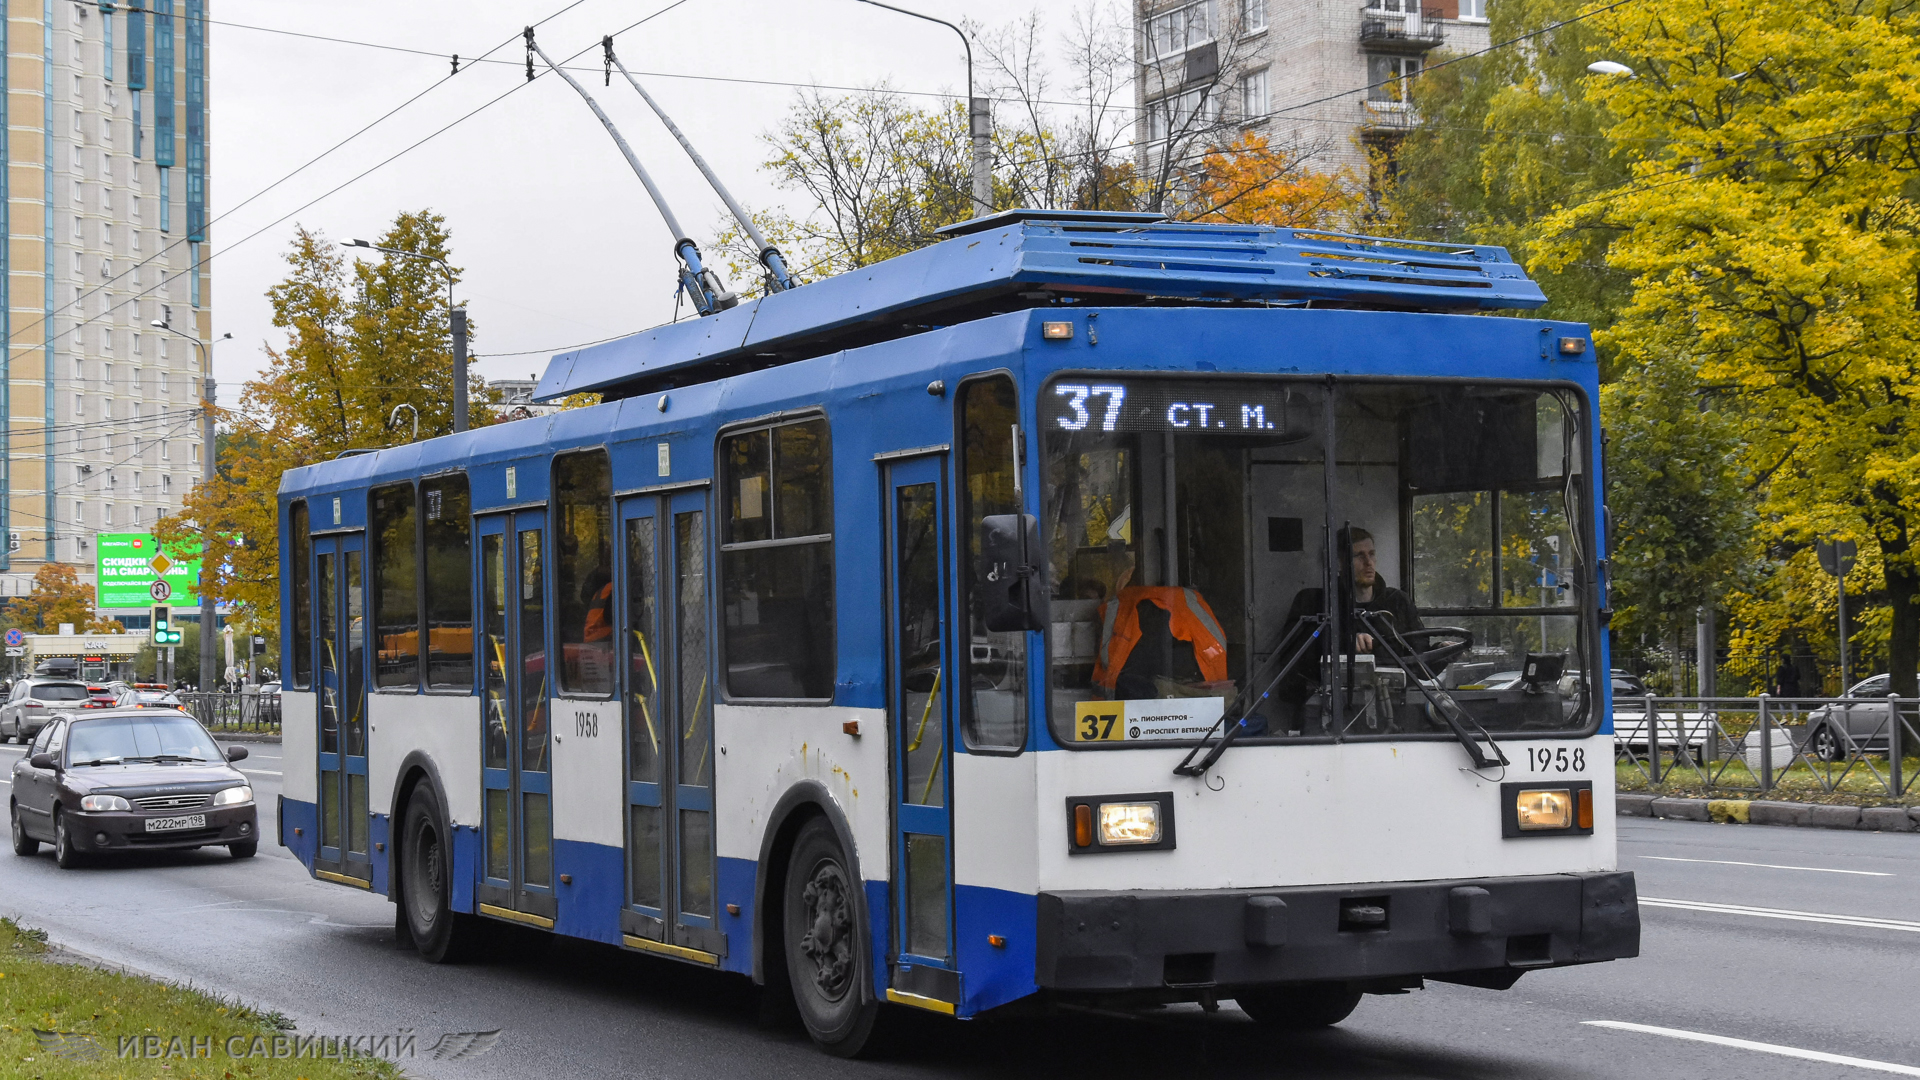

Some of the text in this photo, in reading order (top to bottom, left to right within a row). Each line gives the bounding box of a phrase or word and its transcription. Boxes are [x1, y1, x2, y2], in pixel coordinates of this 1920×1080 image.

[1056, 384, 1275, 431] 37 СТ. М.
[102, 557, 146, 566] СКИДКИ
[103, 567, 188, 575] НА СМАРНЫ
[84, 641, 108, 649] КАФЕ
[575, 711, 598, 738] 1958
[1141, 714, 1188, 722] ПИОНЕРСТРОЯ
[1081, 714, 1117, 740] 37
[1527, 747, 1586, 773] 1958
[148, 816, 203, 830] М222МР 198
